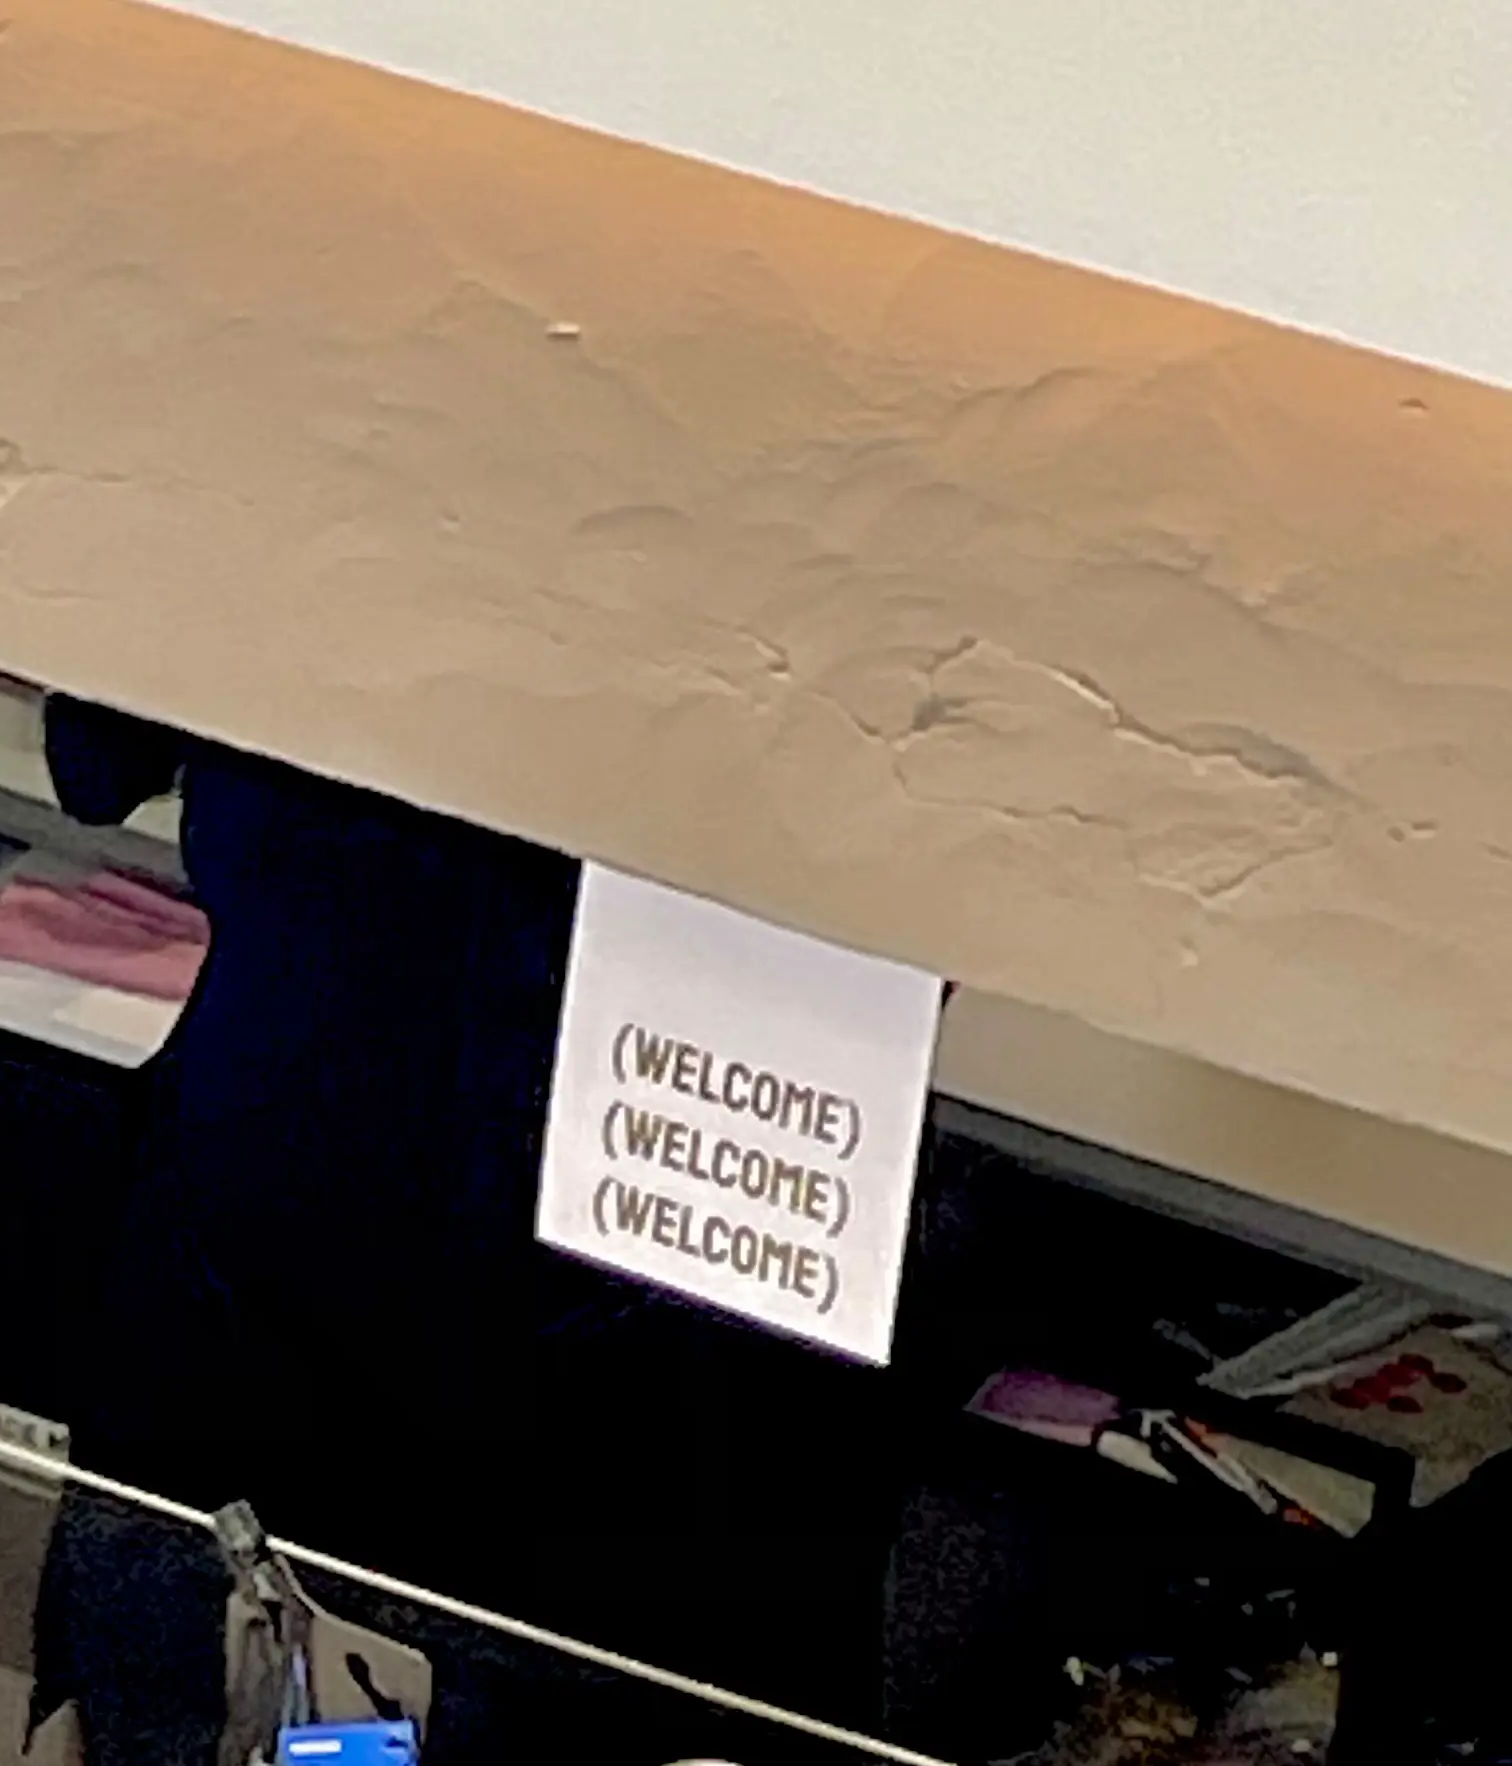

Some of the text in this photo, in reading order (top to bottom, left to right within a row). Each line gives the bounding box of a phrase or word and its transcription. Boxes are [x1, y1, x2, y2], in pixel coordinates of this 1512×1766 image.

[612, 1023, 862, 1161] (WELCOME)
[602, 1100, 851, 1238] (WELCOME)
[592, 1176, 840, 1314] (WELCOME)
